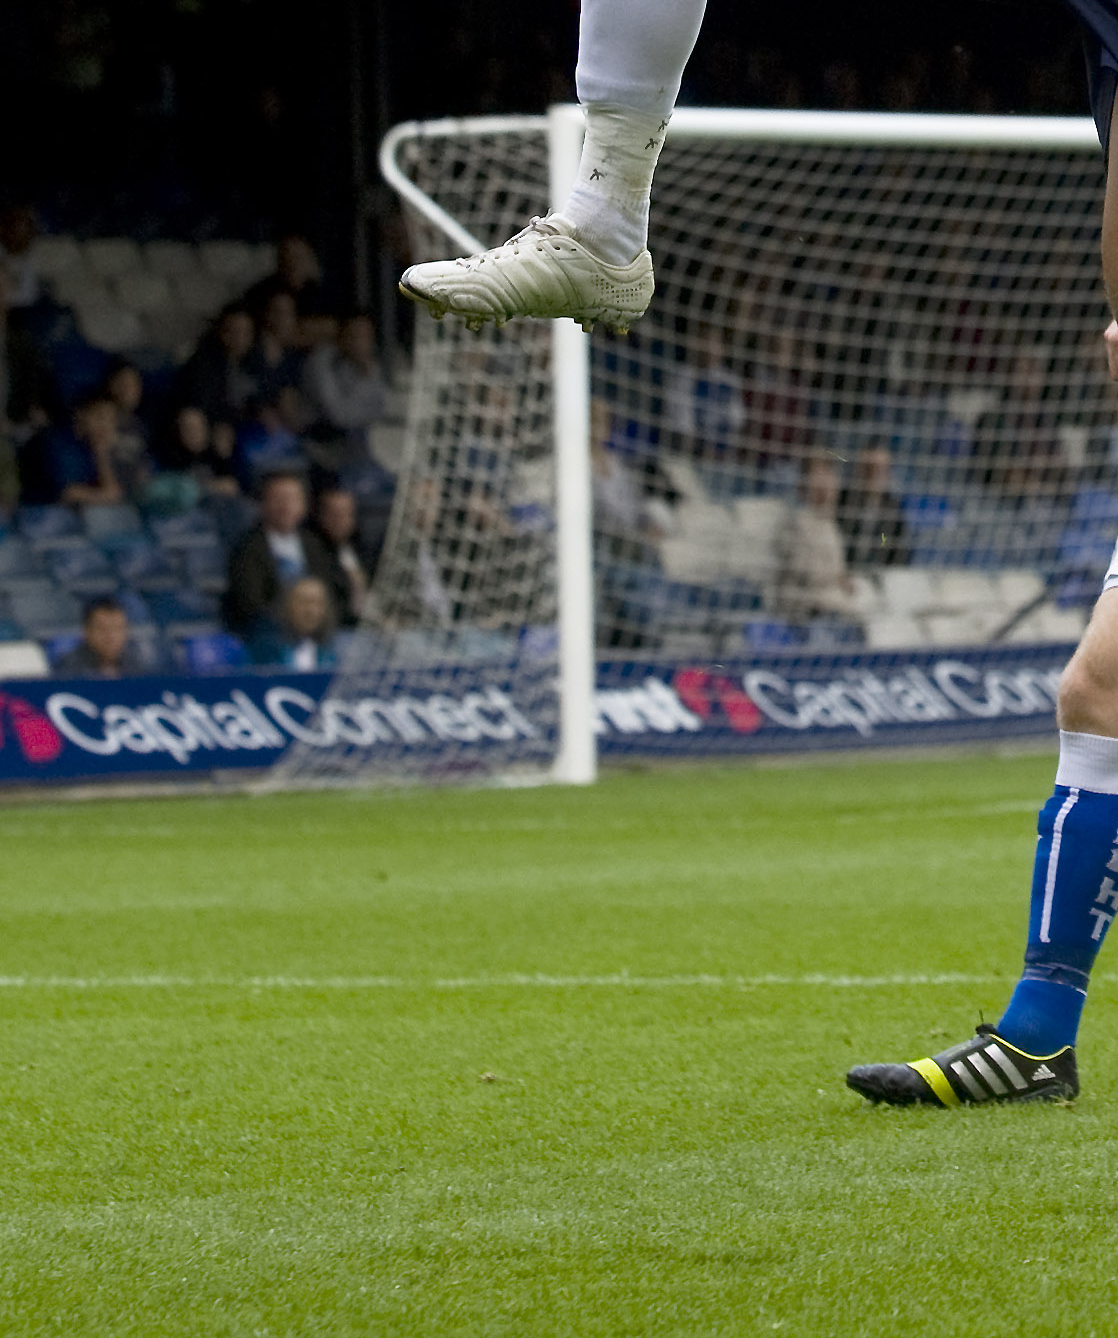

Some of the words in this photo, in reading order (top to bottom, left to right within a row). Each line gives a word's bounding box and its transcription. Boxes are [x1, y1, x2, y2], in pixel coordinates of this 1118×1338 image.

[46, 689, 287, 763] Capital
[266, 686, 539, 747] Connect
[742, 667, 958, 737] Capital
